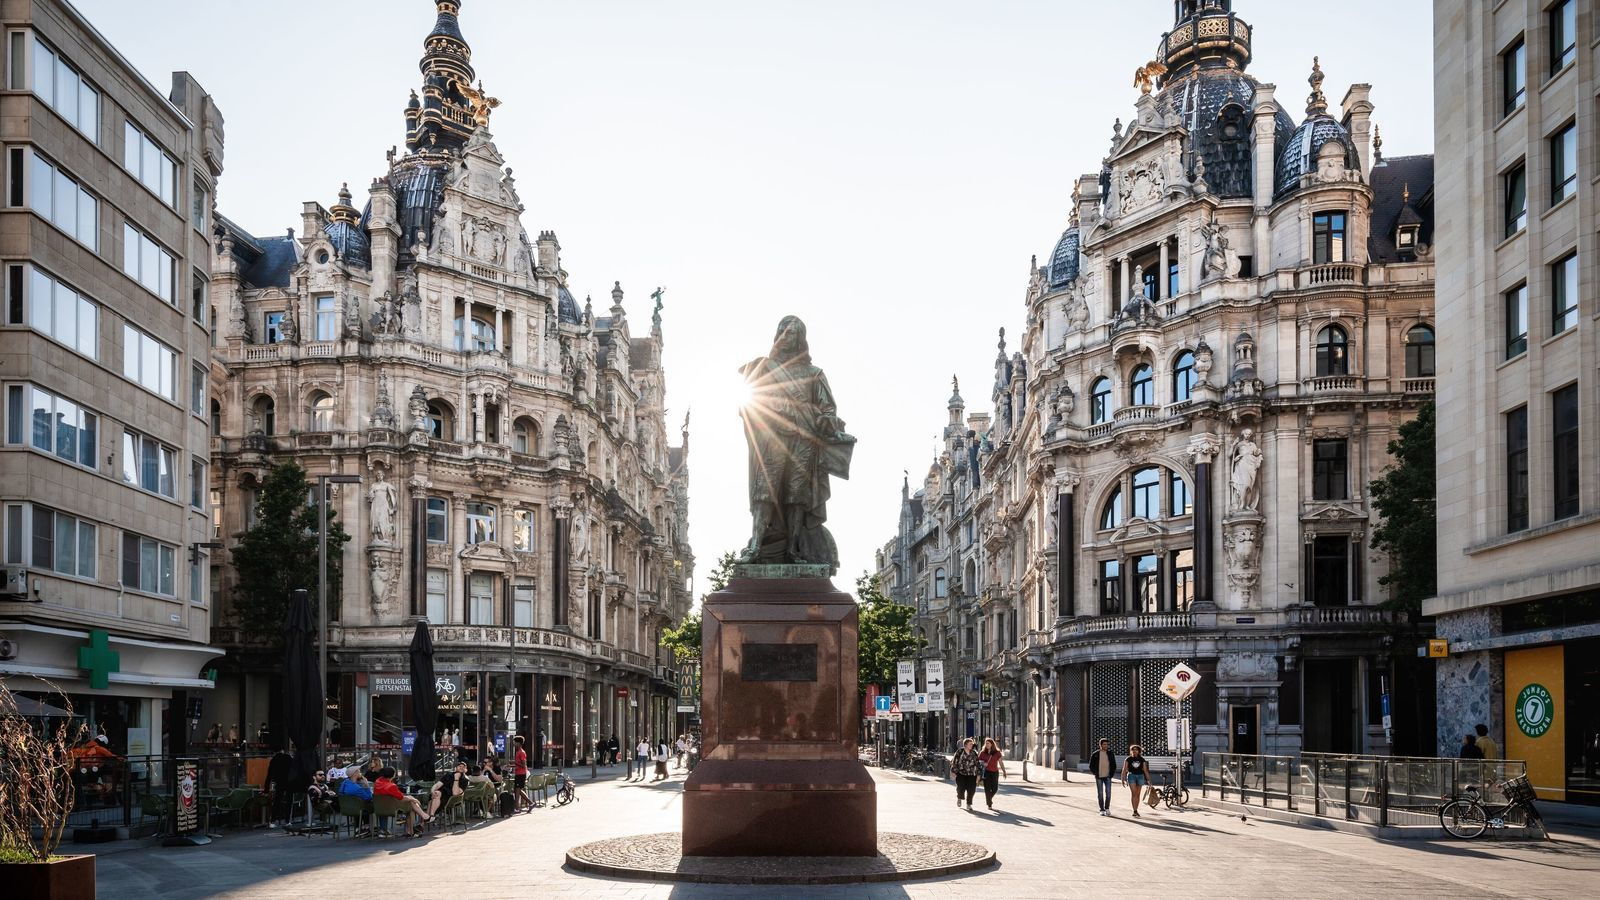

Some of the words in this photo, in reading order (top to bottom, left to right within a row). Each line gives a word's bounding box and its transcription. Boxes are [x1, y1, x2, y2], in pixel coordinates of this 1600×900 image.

[1522, 685, 1551, 704] JUMBO'S
[1530, 701, 1540, 721] 7
[1516, 708, 1551, 735] ZEKERHEDEN
